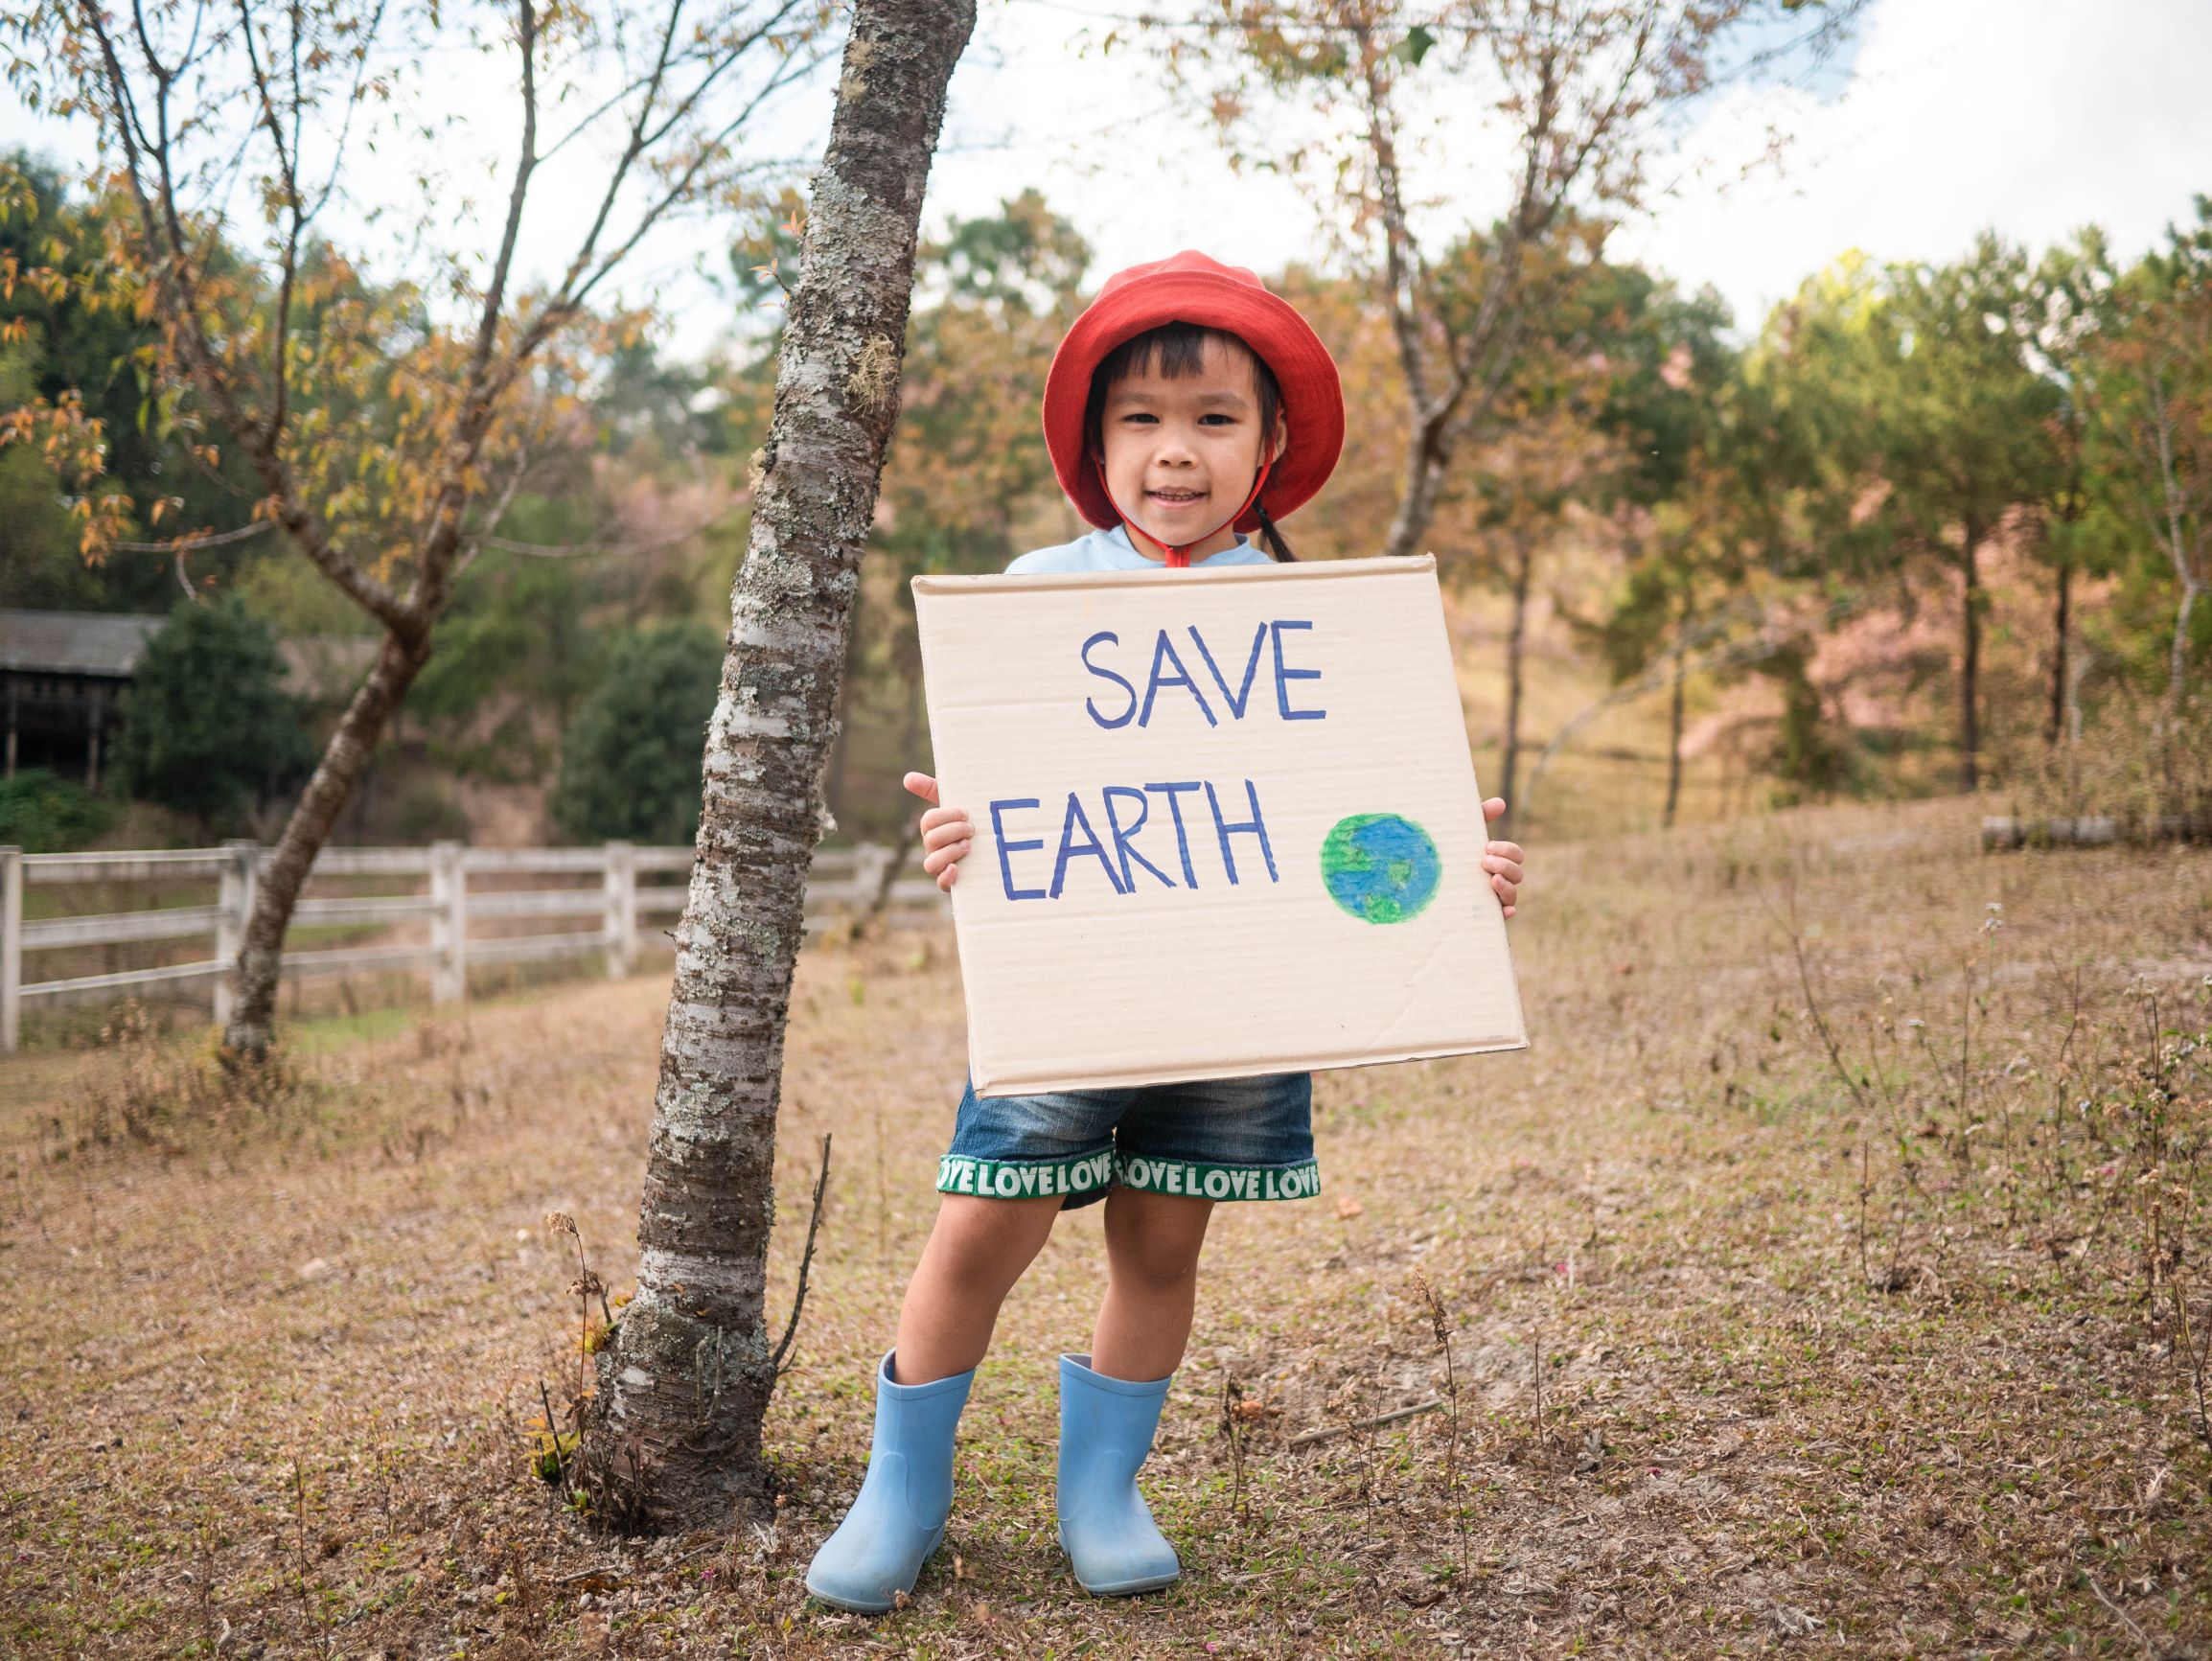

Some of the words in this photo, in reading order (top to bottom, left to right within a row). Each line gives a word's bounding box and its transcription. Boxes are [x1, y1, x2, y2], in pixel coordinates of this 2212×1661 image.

[1081, 620, 1326, 729] SAVE
[989, 779, 1279, 901] EARTH
[978, 1164, 1053, 1197] LOVE
[1057, 1152, 1112, 1193] LOVE
[1186, 1167, 1260, 1198] LOVE
[1266, 1165, 1320, 1198] LOVE
